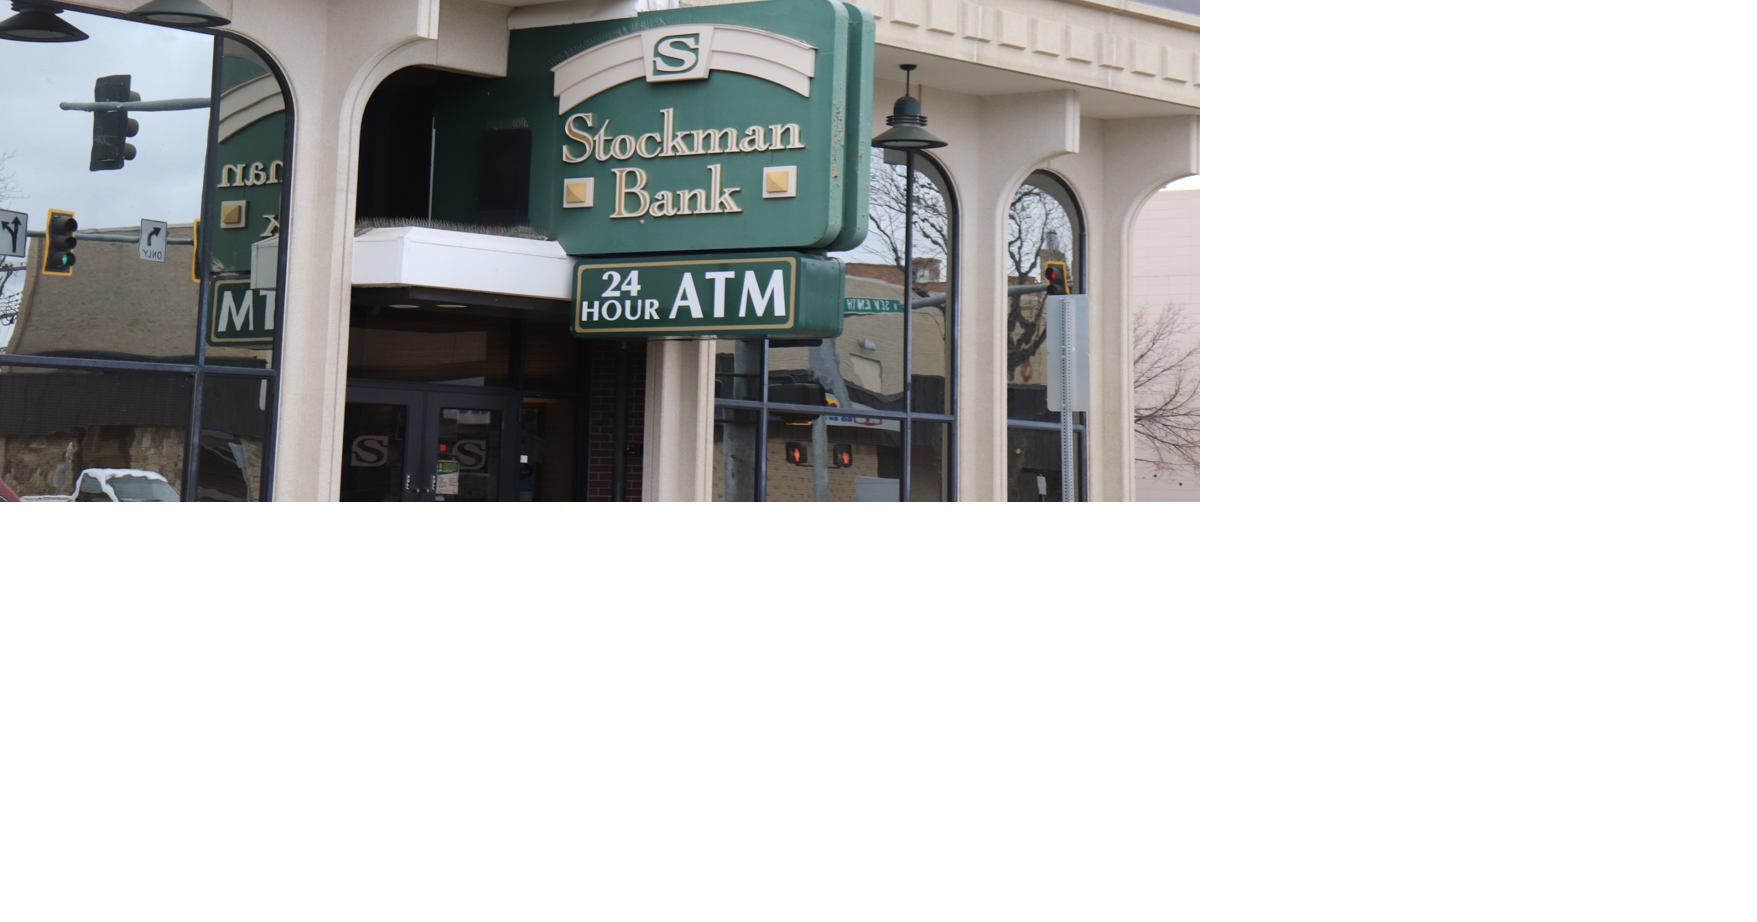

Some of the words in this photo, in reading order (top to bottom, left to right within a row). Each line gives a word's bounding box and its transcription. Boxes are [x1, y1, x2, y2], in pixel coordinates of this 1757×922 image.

[652, 35, 700, 73] S
[562, 107, 806, 163] Stockman
[609, 163, 743, 219] Bank
[601, 270, 641, 297] 24
[668, 269, 786, 320] ATM
[580, 299, 660, 322] HOUR
[351, 435, 389, 467] S
[452, 439, 487, 470] S
